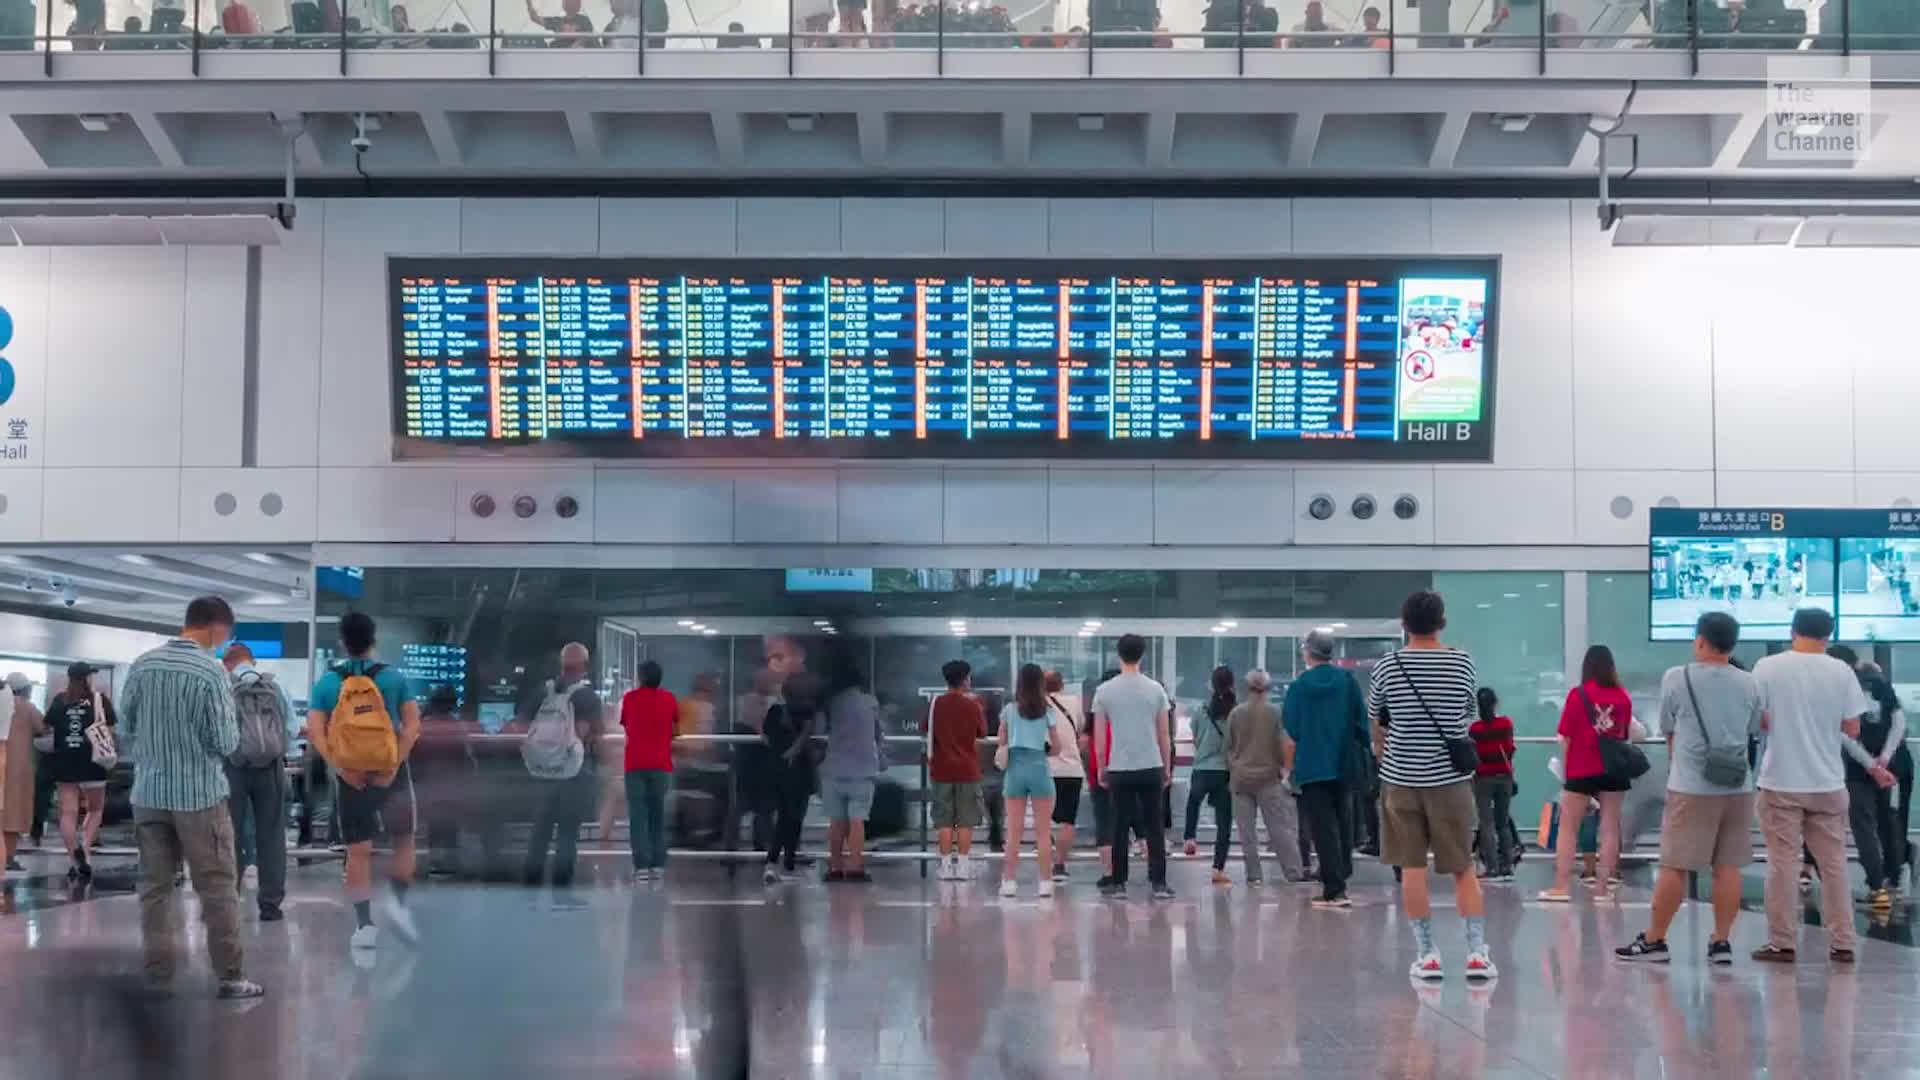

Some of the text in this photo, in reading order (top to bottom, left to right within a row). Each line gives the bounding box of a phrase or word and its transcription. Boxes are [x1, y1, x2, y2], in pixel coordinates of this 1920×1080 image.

[8, 418, 28, 439] 堂
[1407, 422, 1471, 441] Hall B
[1771, 513, 1785, 531] B
